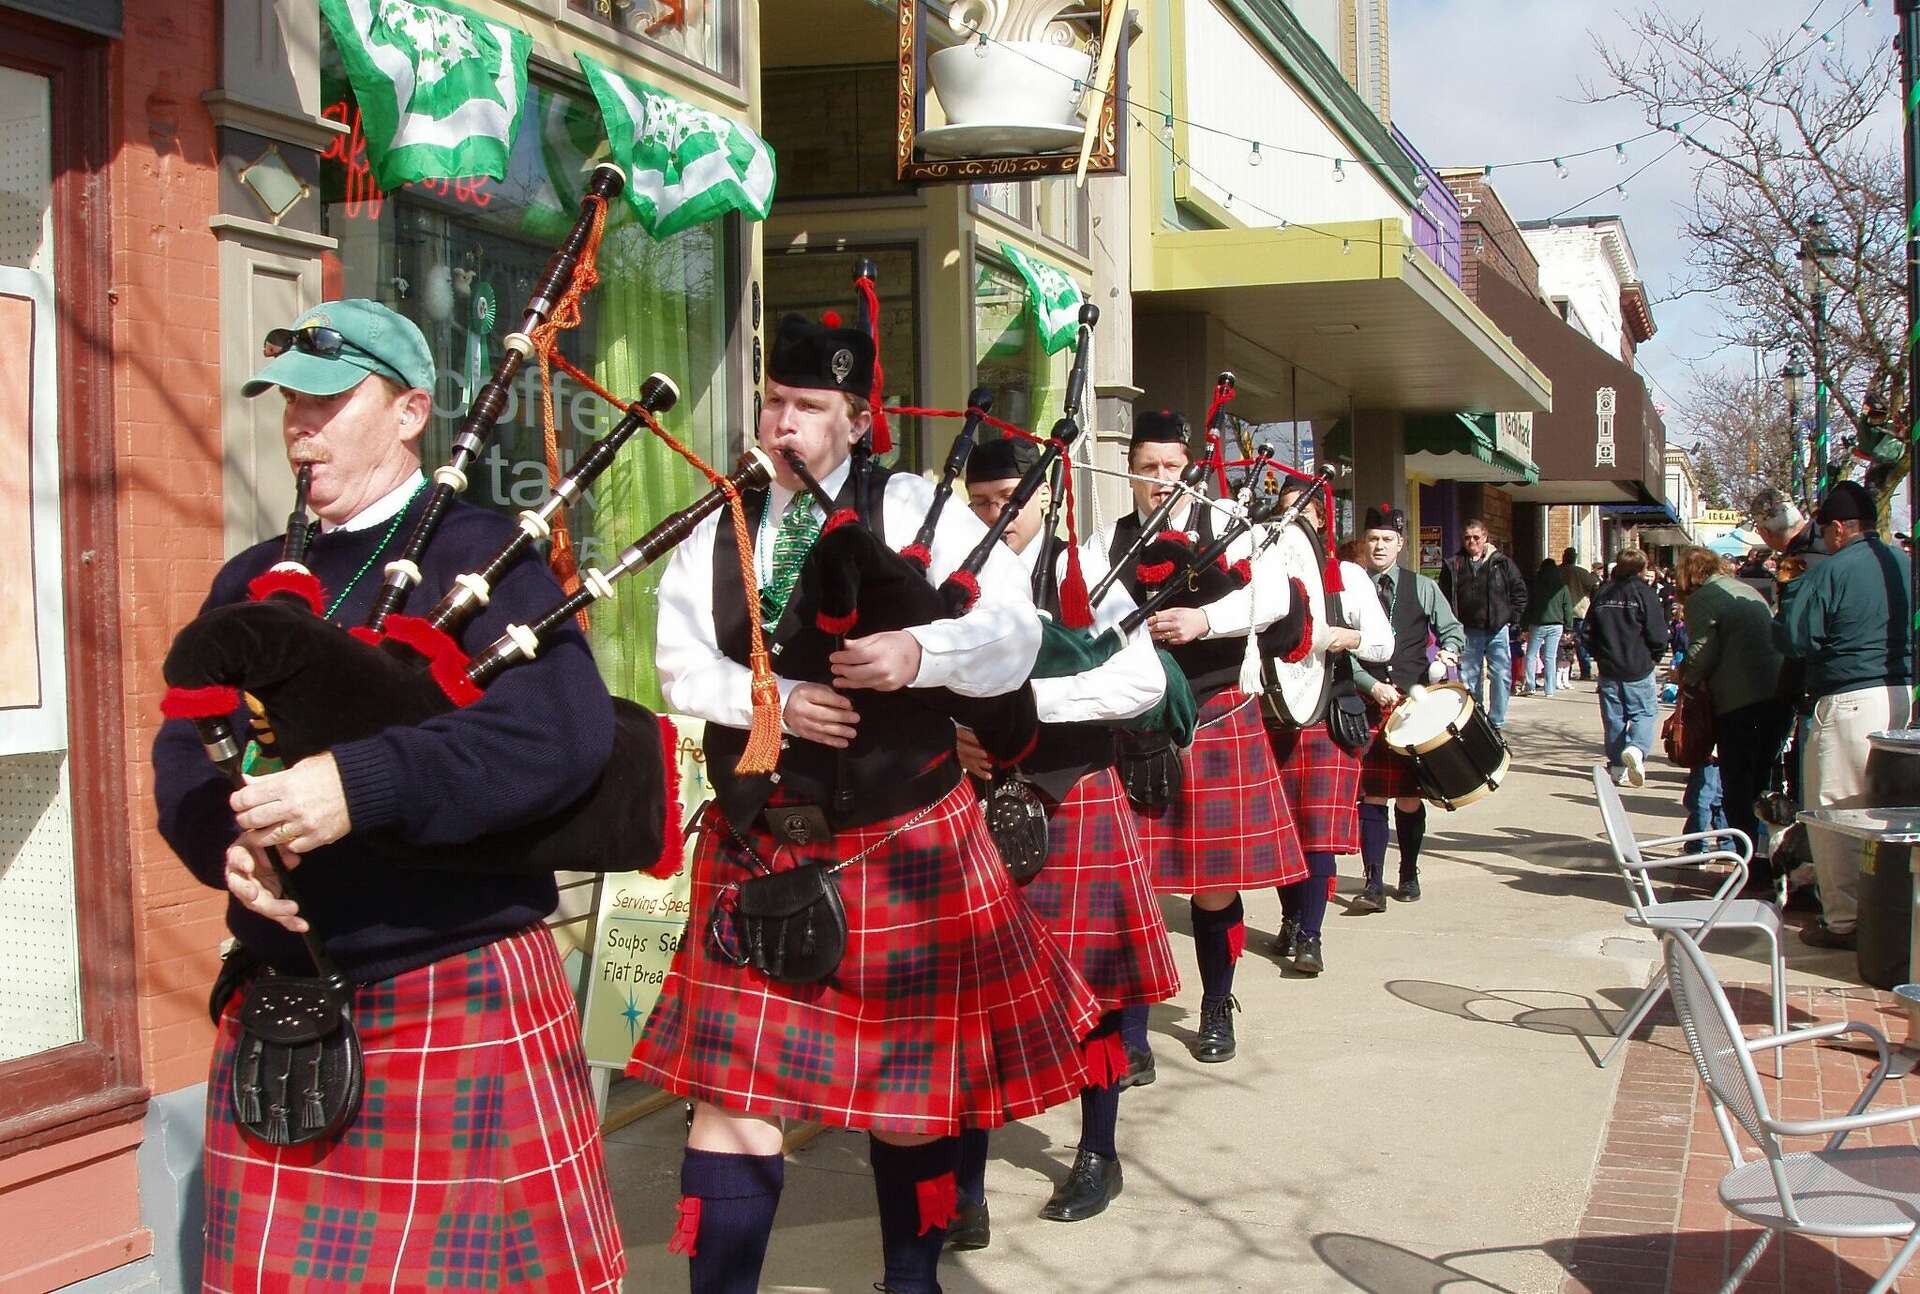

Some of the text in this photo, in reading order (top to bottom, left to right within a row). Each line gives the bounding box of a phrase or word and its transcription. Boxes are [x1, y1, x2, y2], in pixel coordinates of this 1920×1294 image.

[988, 159, 1018, 175] 505
[432, 365, 615, 436] coffe
[1708, 512, 1736, 521] IDEAL
[612, 888, 690, 917] Serving Spec
[608, 928, 648, 959] Soups
[604, 961, 664, 985] Flat Brea
